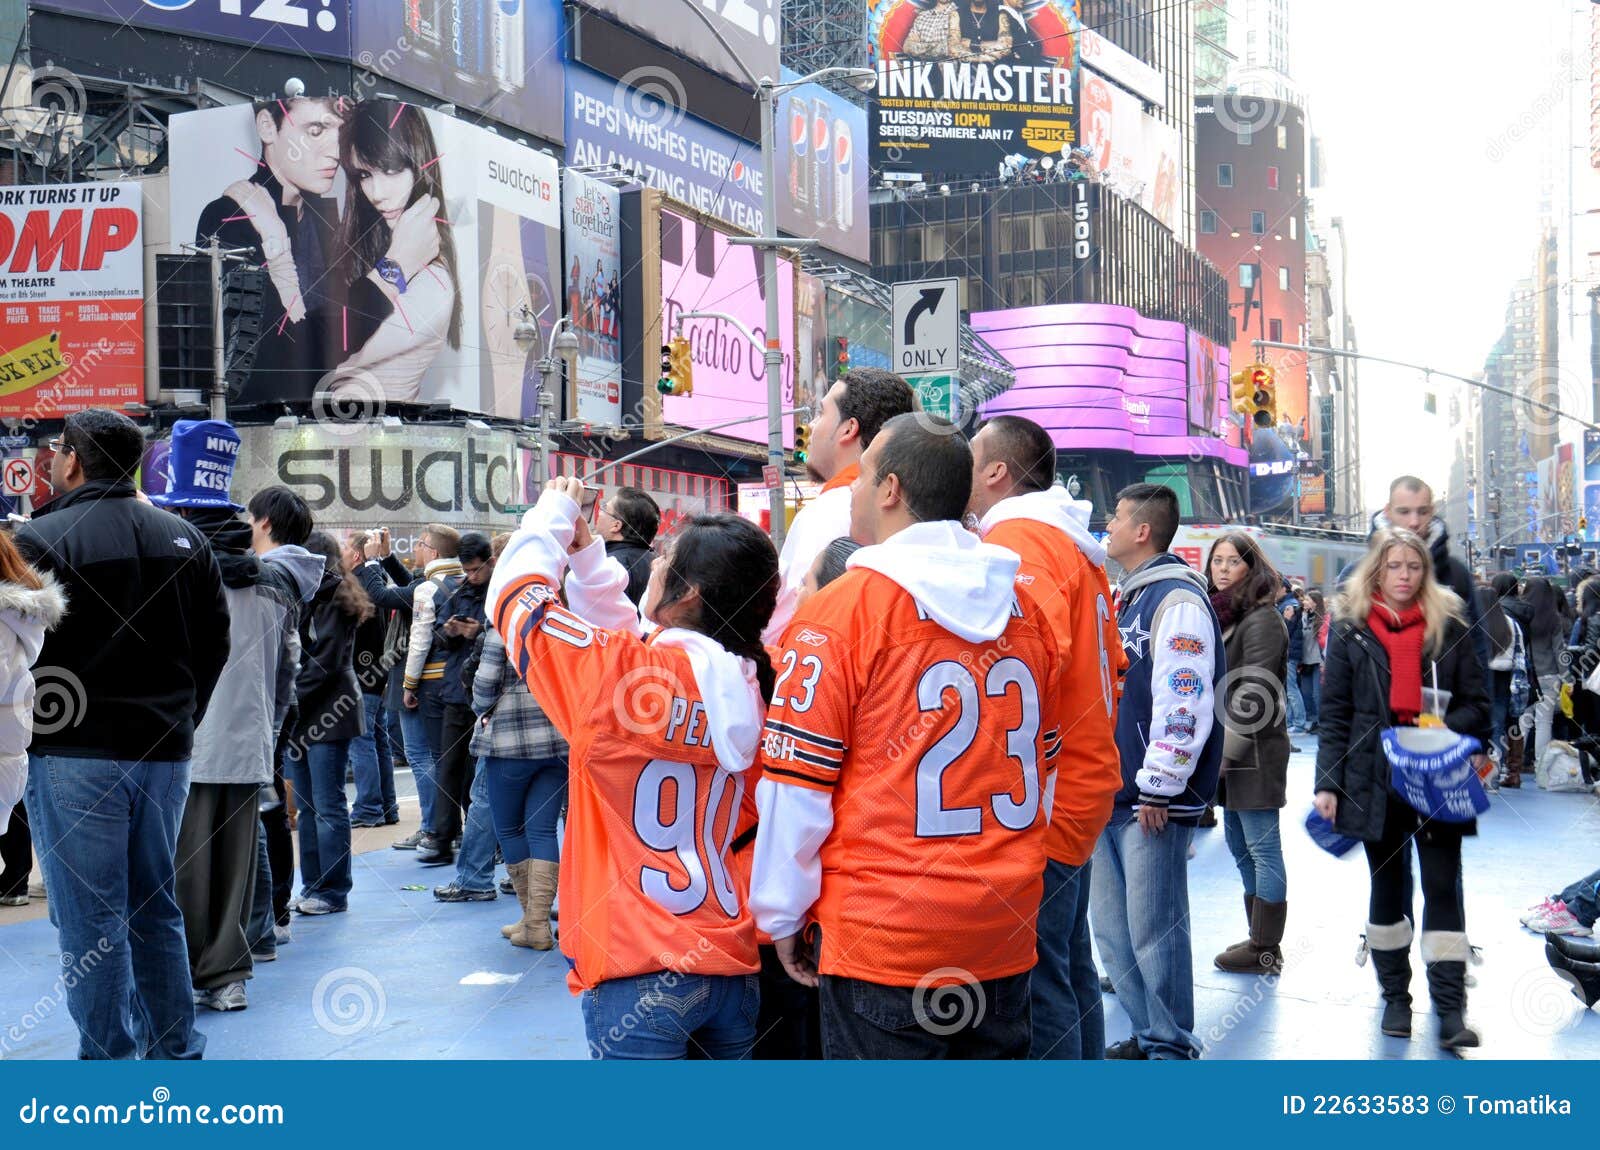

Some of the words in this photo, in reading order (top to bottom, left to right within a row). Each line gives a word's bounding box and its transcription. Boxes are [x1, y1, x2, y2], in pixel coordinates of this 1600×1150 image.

[878, 60, 935, 98] INK
[943, 61, 1073, 105] MASTER
[879, 110, 953, 127] TUESDAYS
[955, 112, 990, 128] 10PM
[962, 101, 977, 110] WITH
[979, 102, 1001, 112] OLIVER
[1002, 103, 1018, 112] PECK
[1019, 104, 1032, 113] AND
[574, 91, 620, 136] PEPSI
[625, 113, 687, 163] WISHES
[879, 125, 919, 137] SERIES
[921, 126, 977, 139] PREMIERE
[978, 128, 1001, 140] JAN
[1003, 129, 1014, 141] 17
[1021, 128, 1076, 142] SPIKE
[30, 188, 77, 205] TURNS
[82, 187, 96, 203] IT
[100, 187, 120, 202] UP
[488, 159, 541, 199] swatch
[573, 139, 602, 172] AN
[607, 150, 685, 203] AMAZING
[689, 181, 725, 218] NEW
[728, 198, 764, 236] YEAR
[0, 207, 139, 273] MP
[572, 207, 614, 238] together
[1074, 183, 1090, 259] 1500
[12, 277, 56, 288] THEATRE
[0, 362, 25, 386] CK
[21, 347, 61, 375] FLY
[902, 348, 949, 369] ONLY
[278, 437, 516, 514] swatc
[770, 649, 823, 713] 23
[914, 656, 1041, 838] 23
[1149, 774, 1162, 788] NFL
[632, 758, 746, 919] 90
